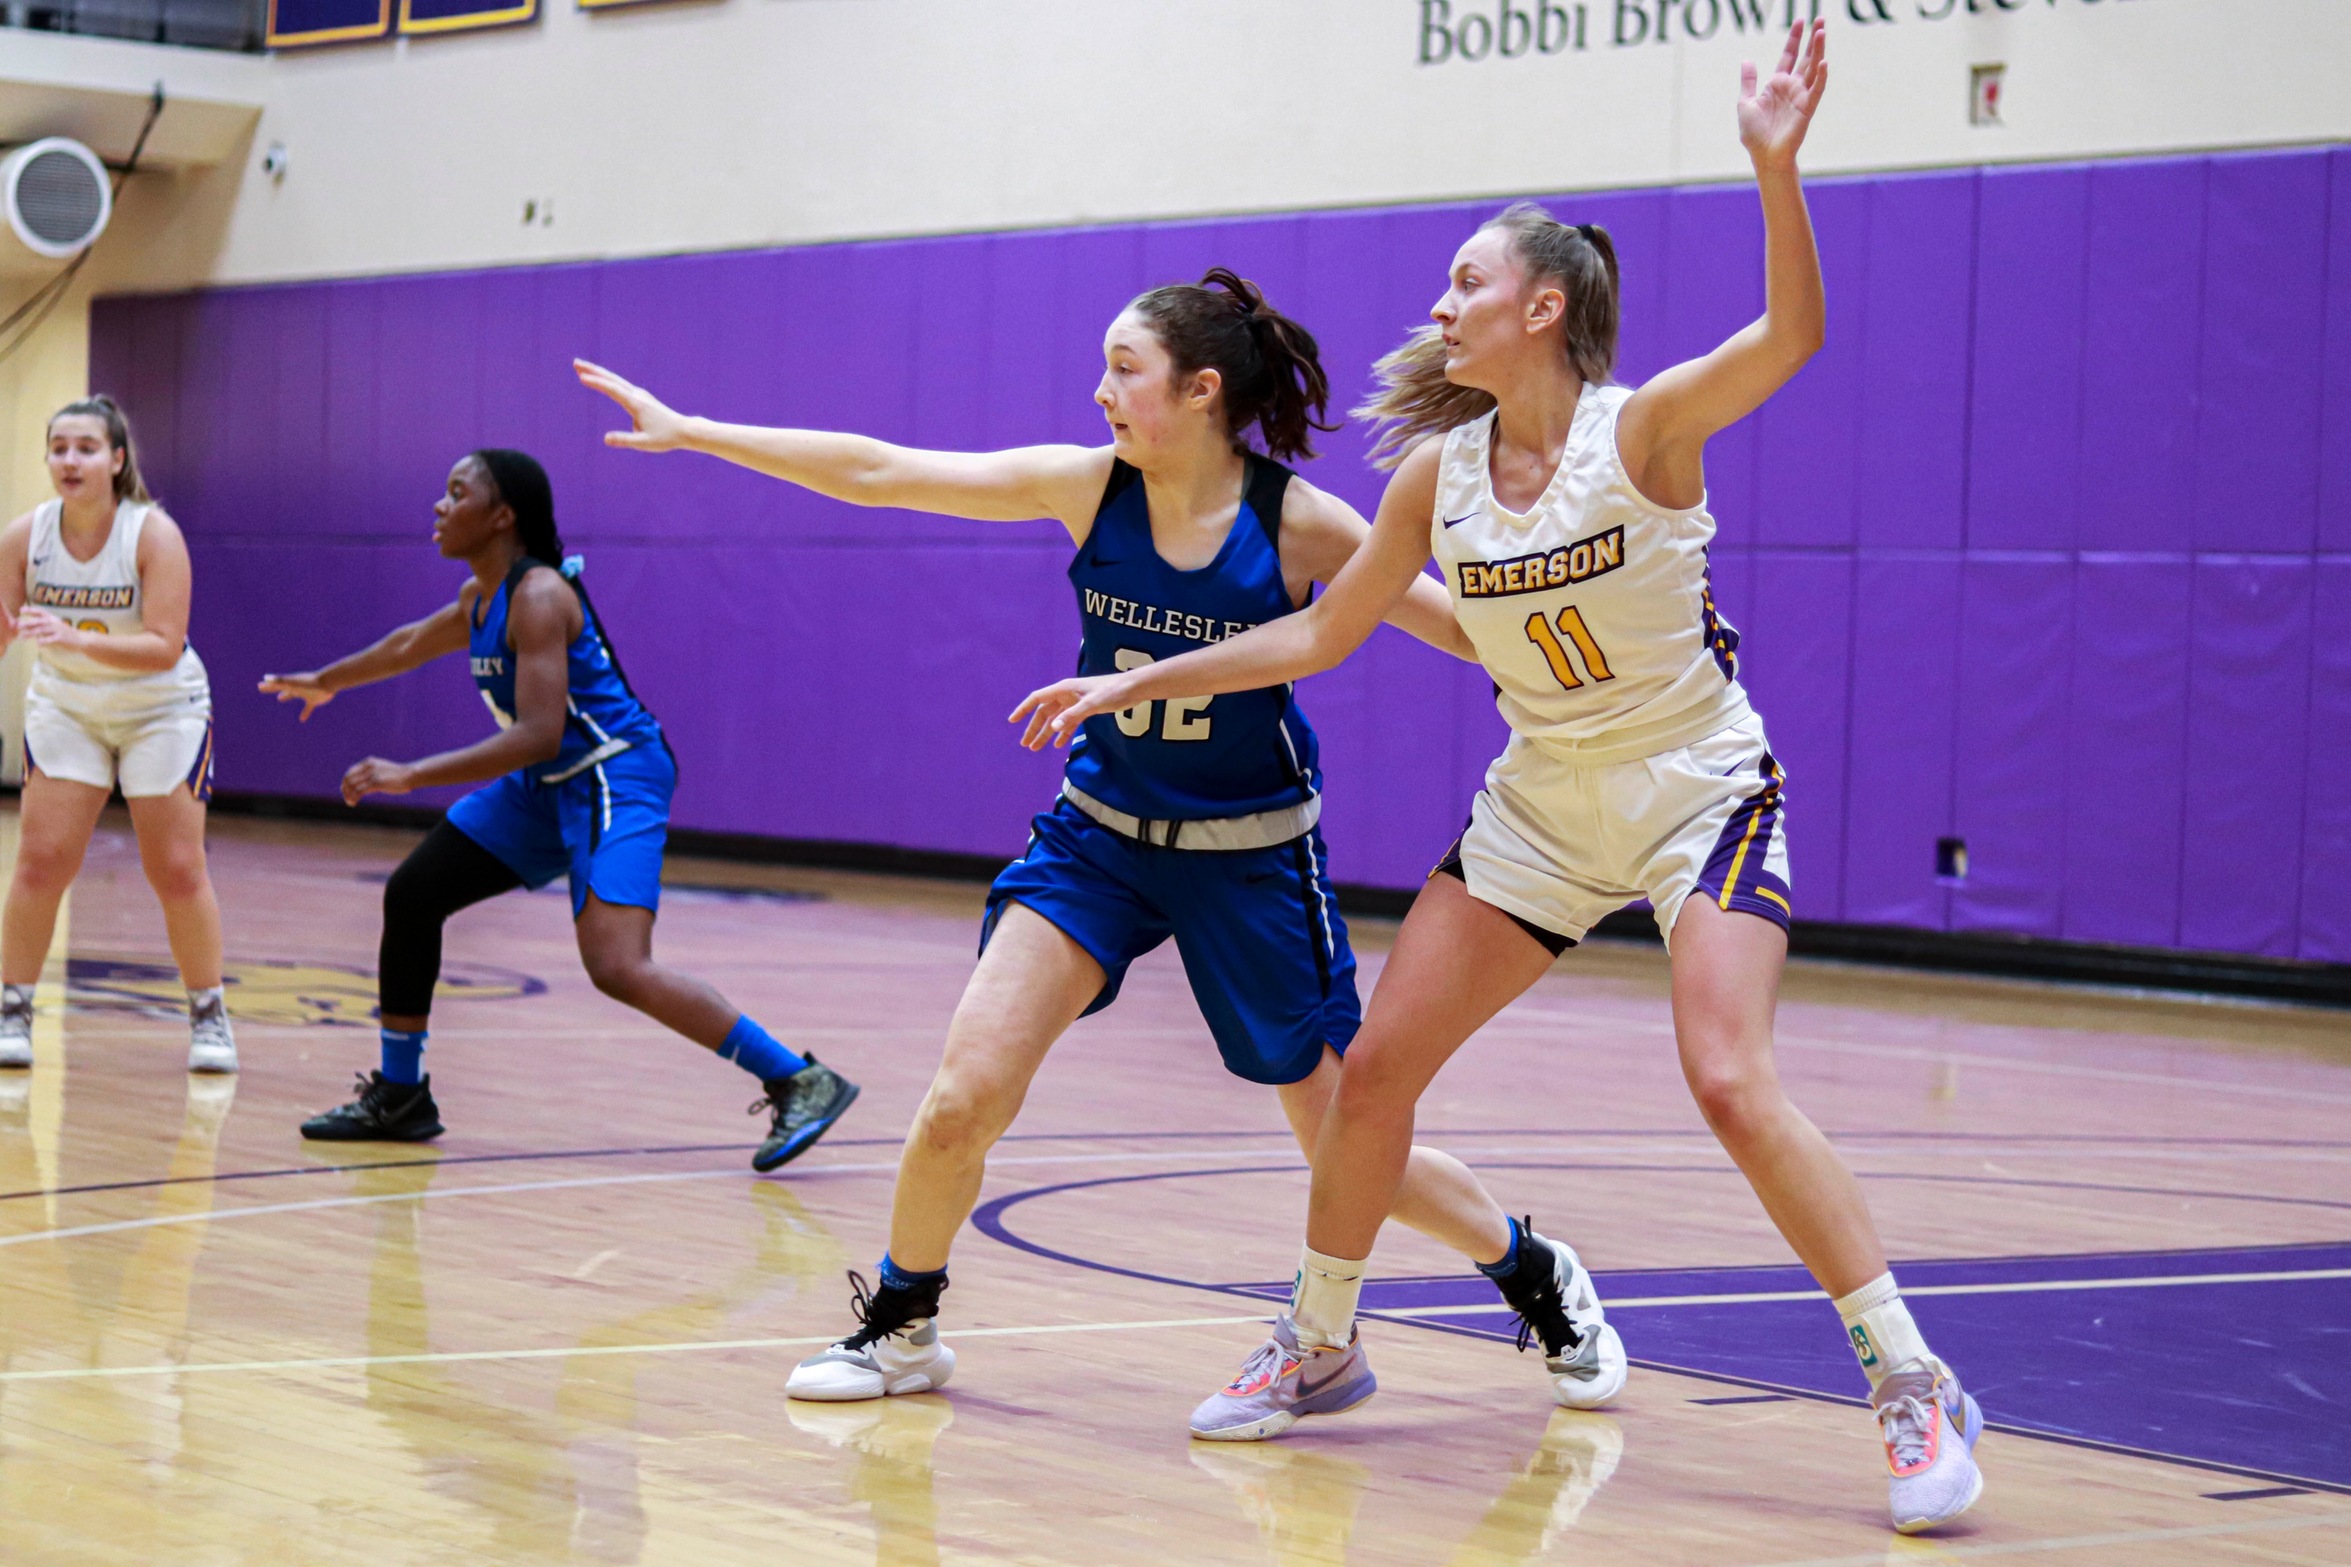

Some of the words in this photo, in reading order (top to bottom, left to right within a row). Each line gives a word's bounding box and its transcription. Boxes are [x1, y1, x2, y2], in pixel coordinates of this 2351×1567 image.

[1415, 0, 1589, 67] Bobbi
[1612, 0, 1822, 47] Brown
[1459, 528, 1622, 596] EMERSON
[1084, 588, 1257, 645] WELLESLE
[1524, 605, 1616, 691] 11
